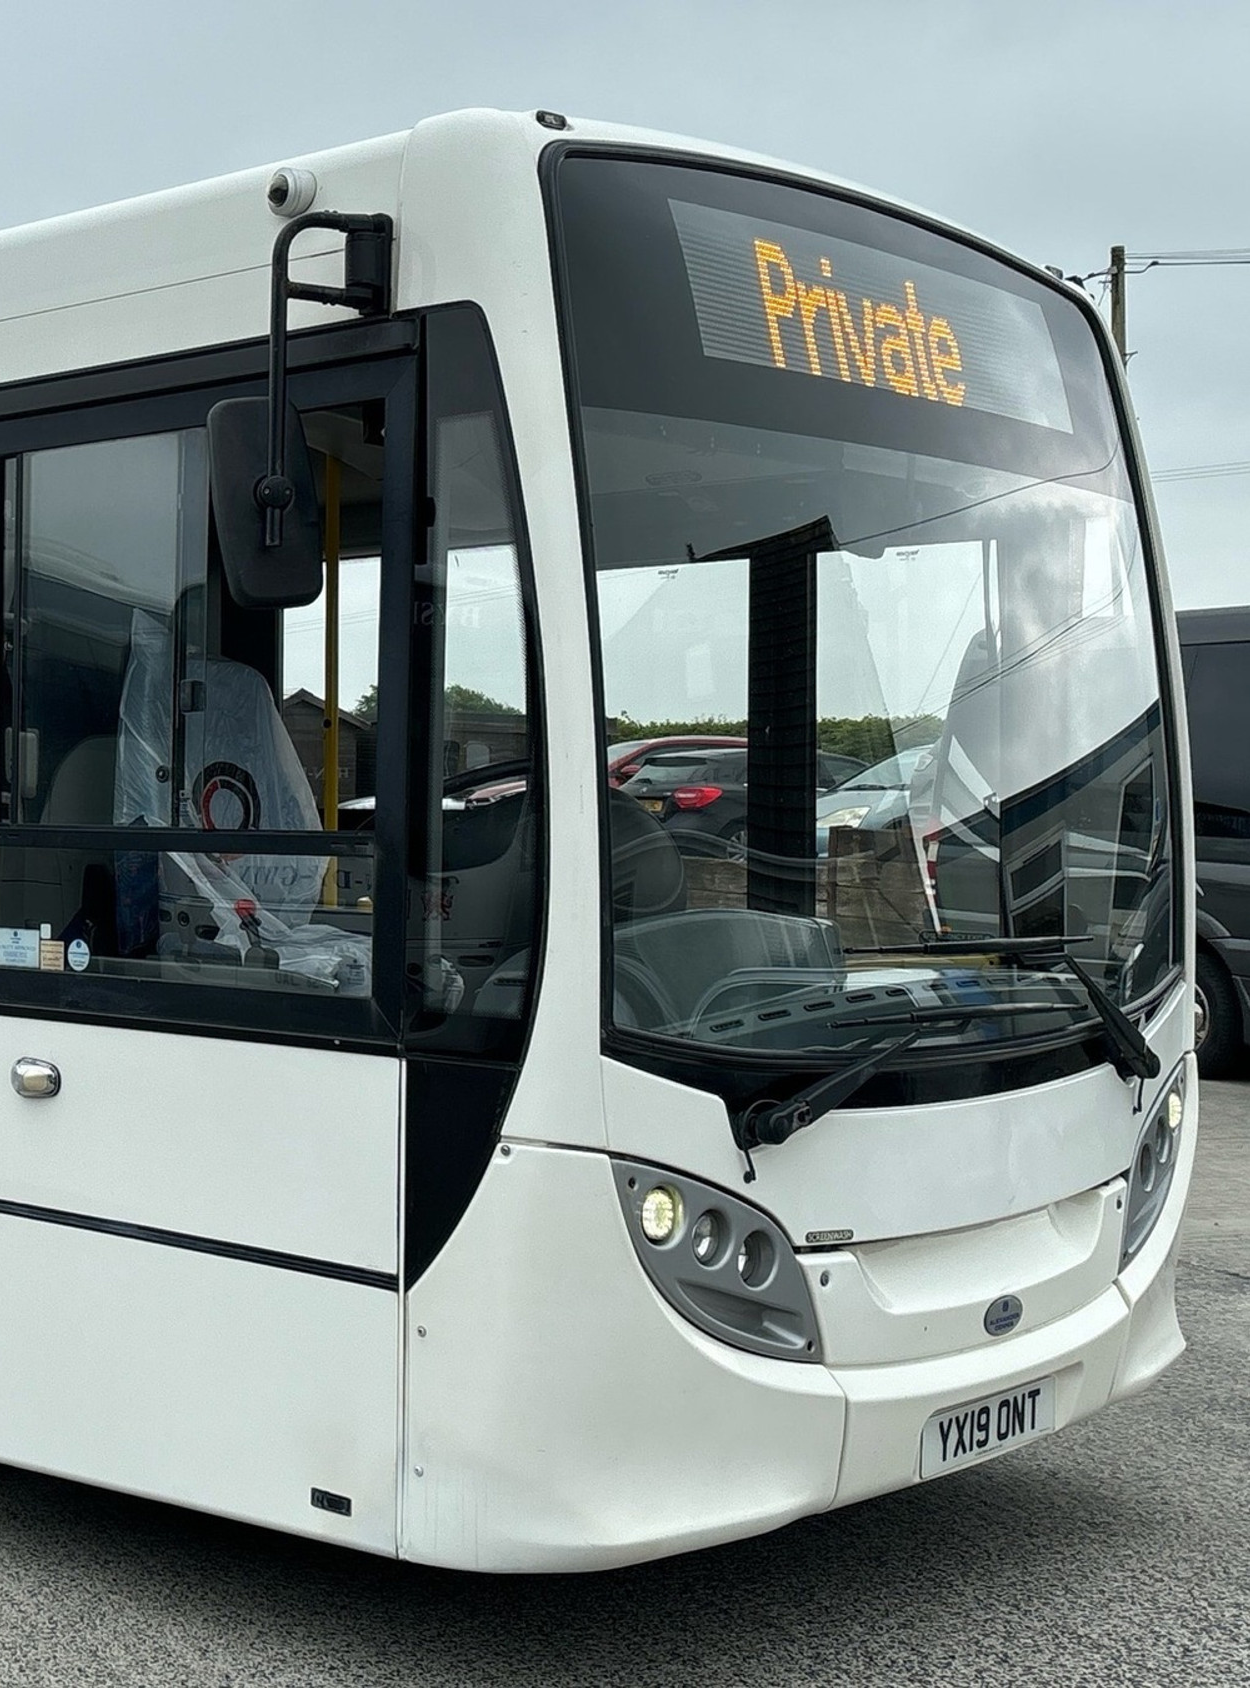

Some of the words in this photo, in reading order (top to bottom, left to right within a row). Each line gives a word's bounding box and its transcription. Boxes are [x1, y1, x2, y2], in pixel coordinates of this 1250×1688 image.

[753, 238, 966, 407] Private
[807, 1230, 852, 1242] SCREENWASH
[939, 1406, 990, 1462] YX19
[997, 1388, 1041, 1441] ONT
